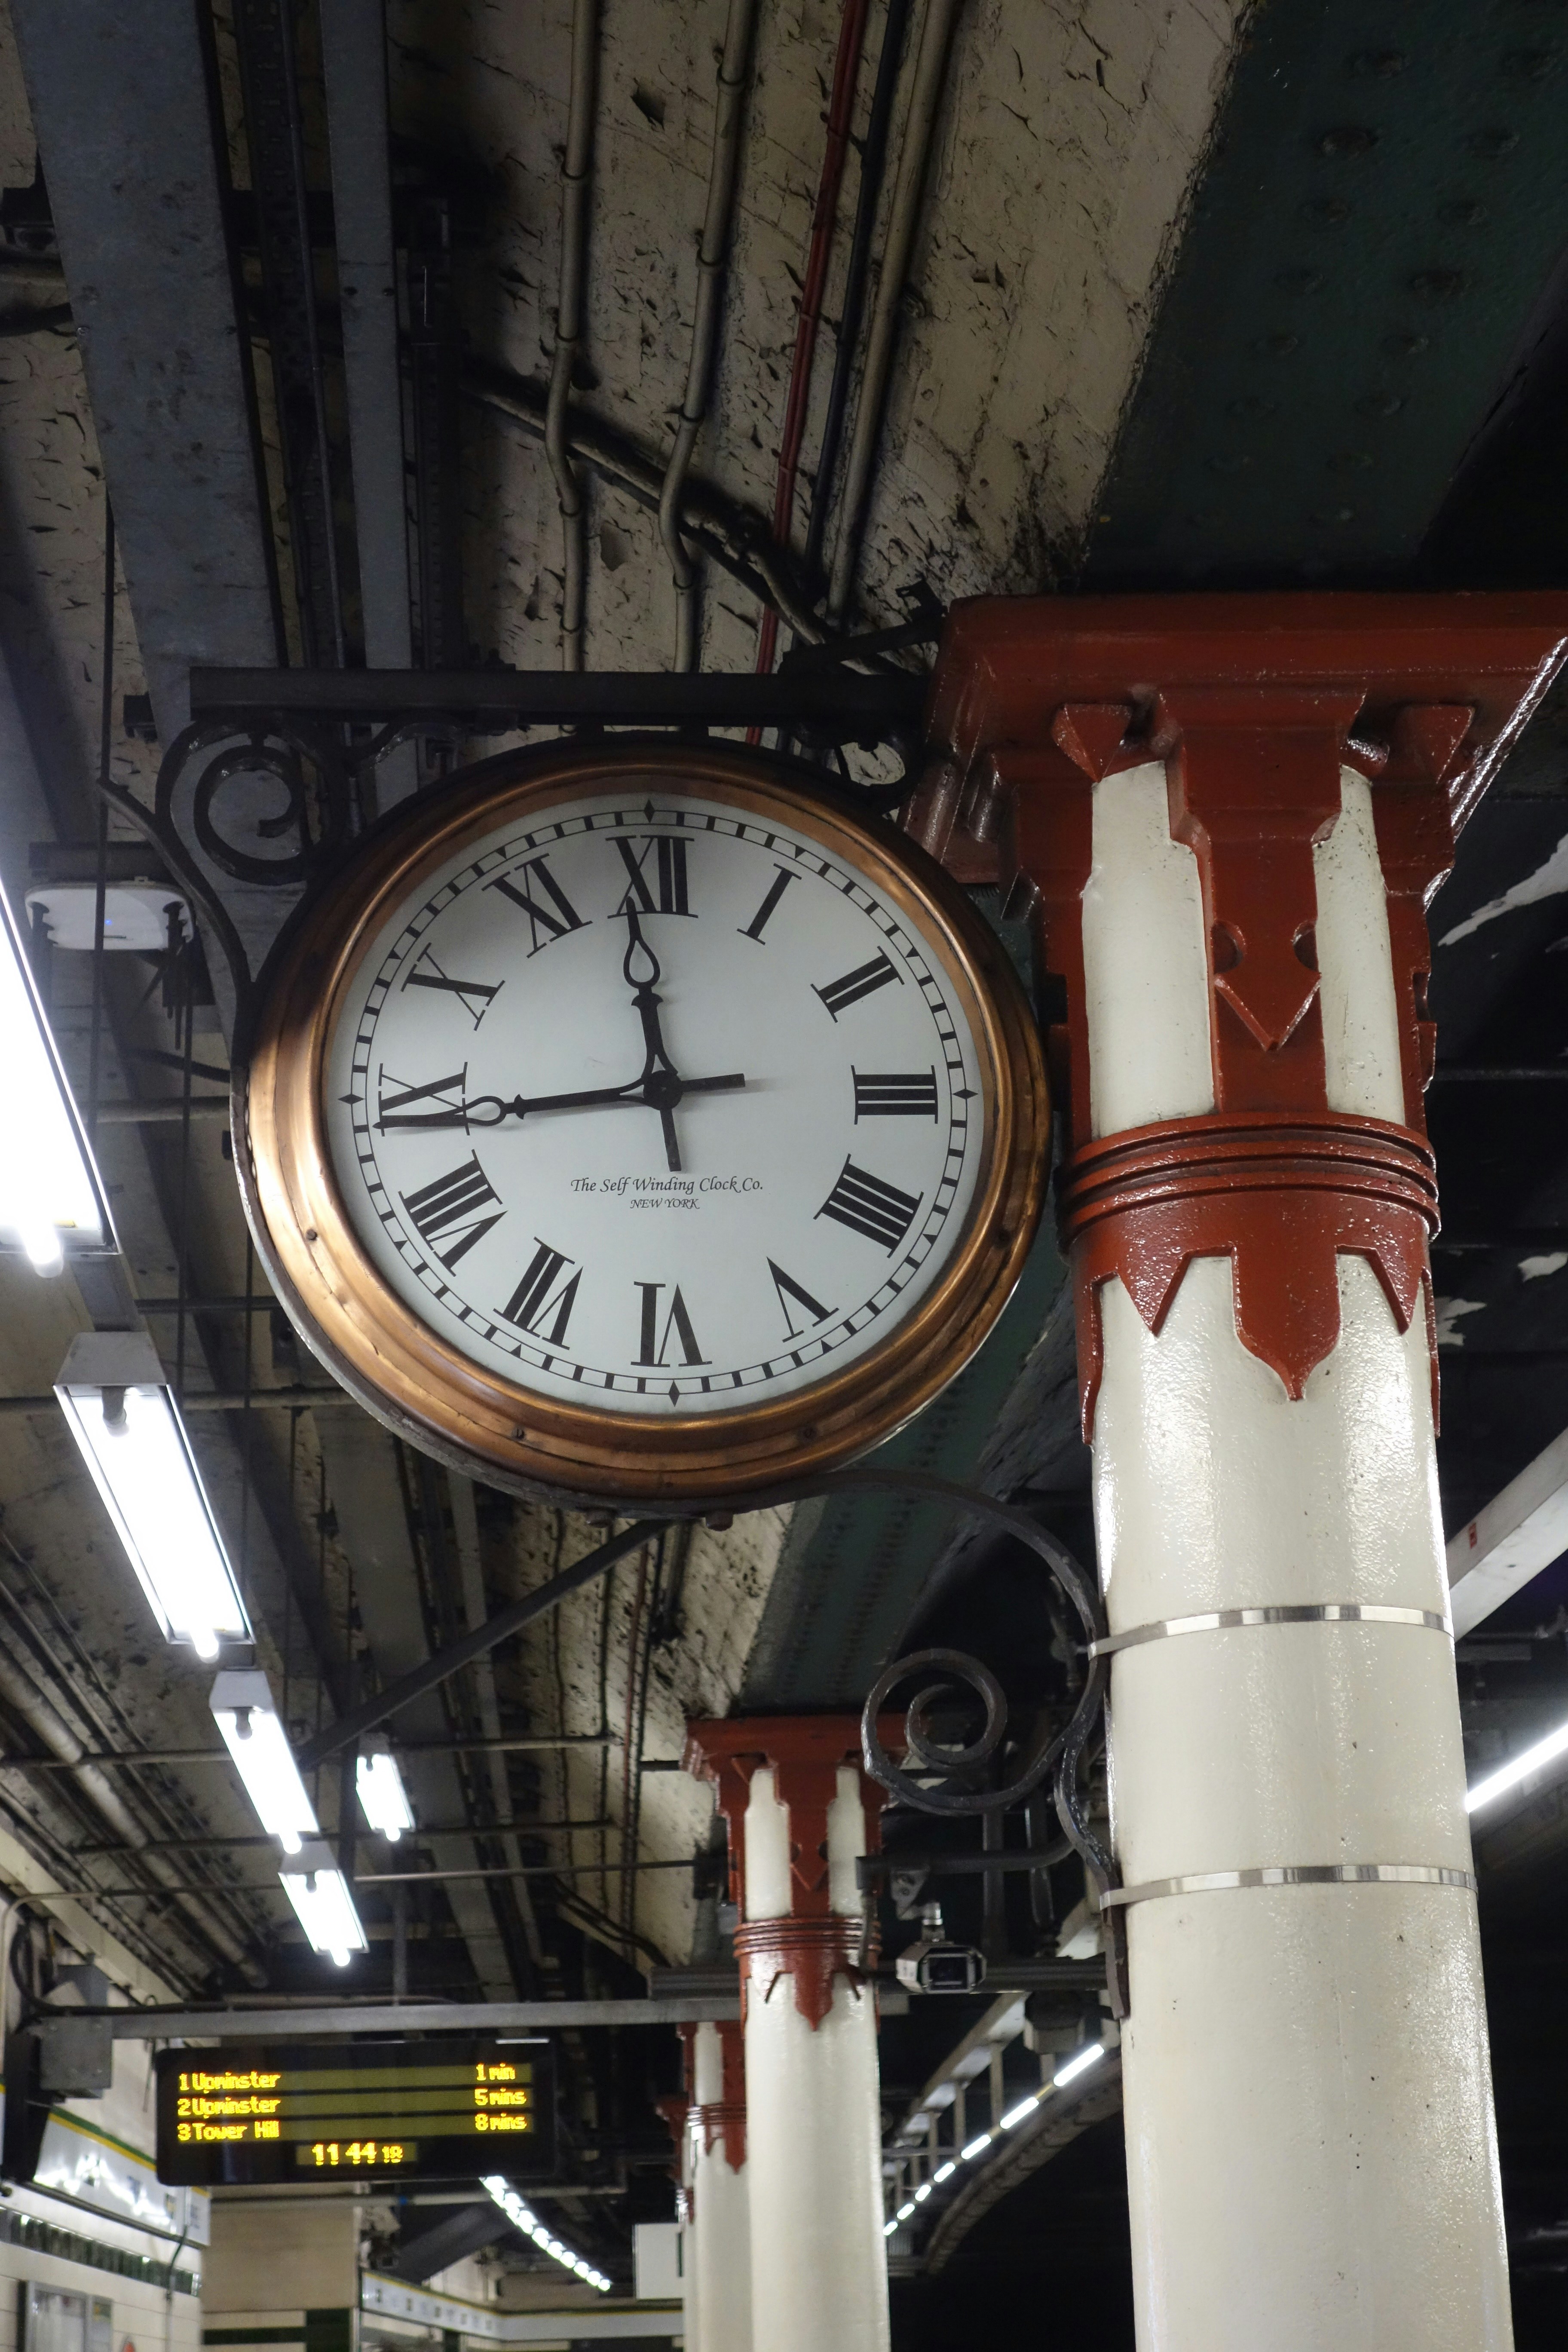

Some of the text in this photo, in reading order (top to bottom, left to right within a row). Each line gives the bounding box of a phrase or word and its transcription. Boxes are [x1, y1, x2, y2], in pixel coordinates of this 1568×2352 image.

[481, 853, 592, 959] XI
[606, 835, 698, 919] XII
[737, 862, 802, 946] I
[401, 943, 505, 1031] X
[810, 946, 905, 1023] II
[851, 1065, 939, 1125] III
[398, 1149, 508, 1277] VIII
[571, 1176, 763, 1195] The Self Winding Clock Co.
[630, 1198, 700, 1210] NEW YORK
[813, 1153, 925, 1259] IIII
[493, 1237, 584, 1350] VII
[631, 1281, 713, 1368] VI
[766, 1256, 839, 1343] V
[177, 2096, 281, 2119] 2 Upminster
[179, 2070, 281, 2094] 1 Upminster
[475, 2088, 527, 2106] 5 mins
[476, 2063, 516, 2081] 1 min
[177, 2120, 279, 2141] 3 Tower Hill
[475, 2113, 527, 2131] 8 mins
